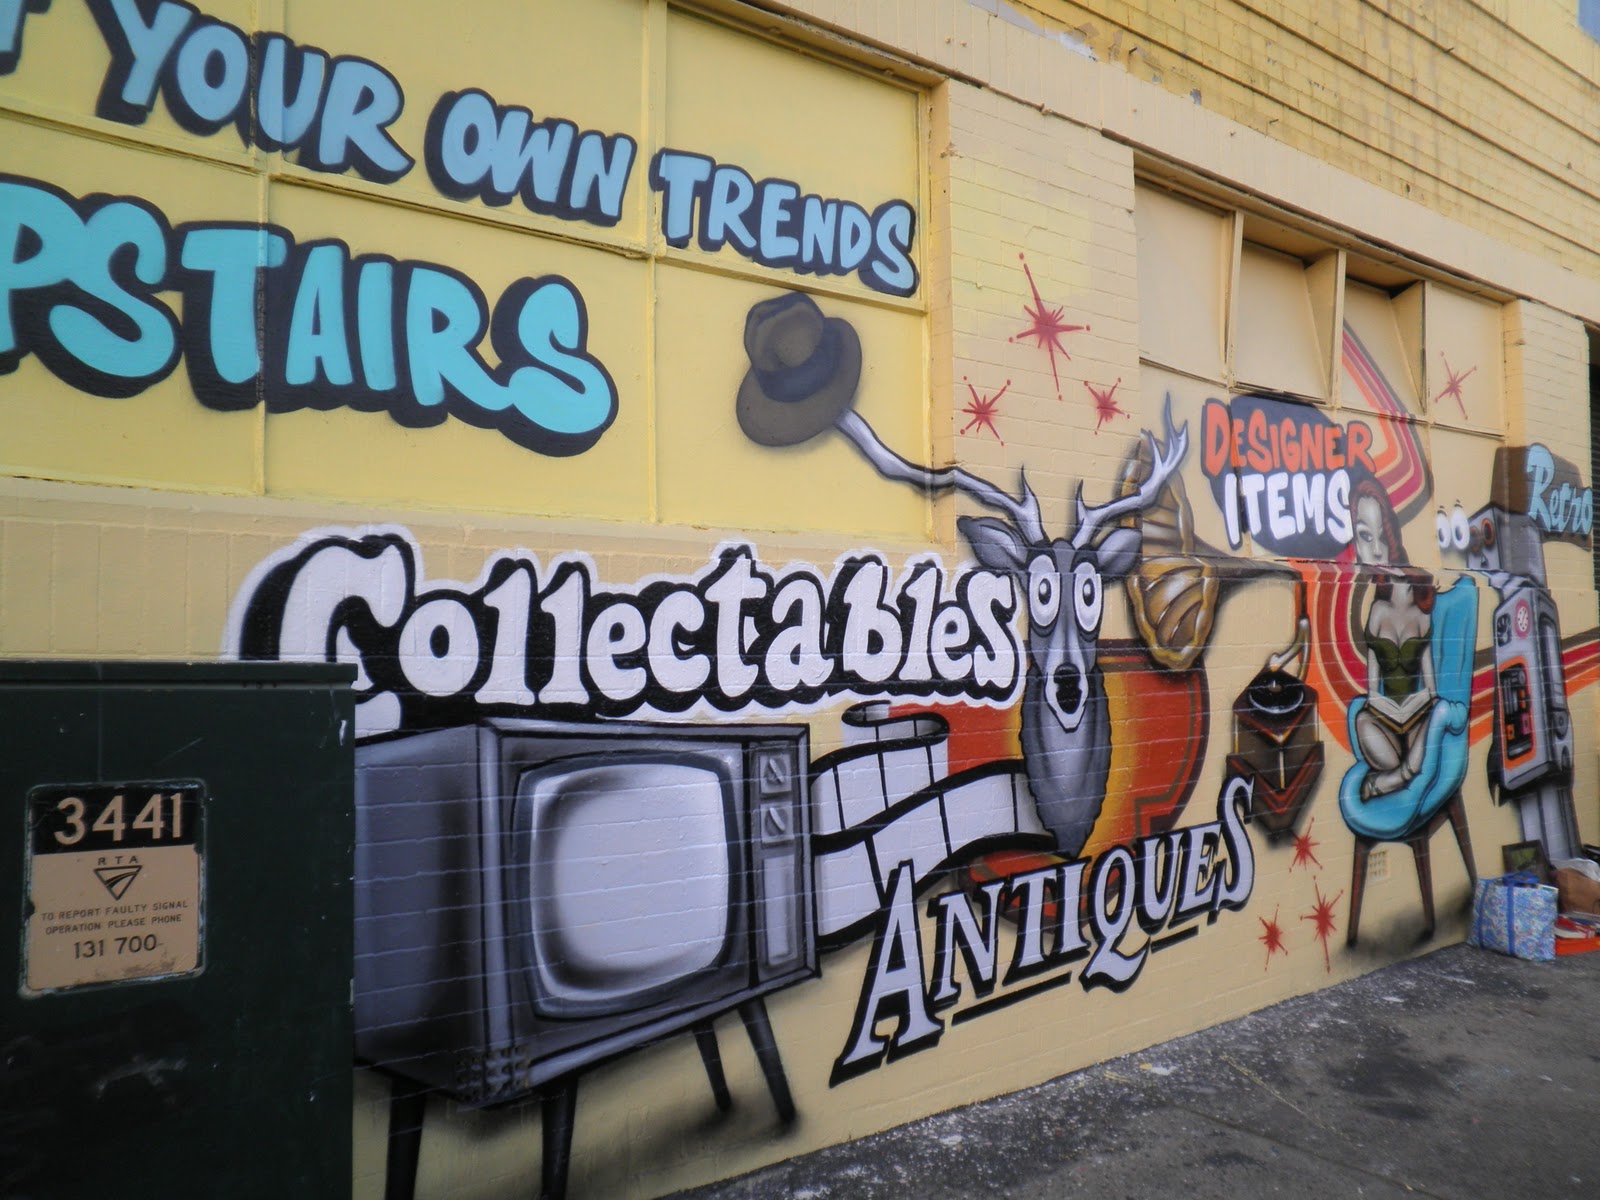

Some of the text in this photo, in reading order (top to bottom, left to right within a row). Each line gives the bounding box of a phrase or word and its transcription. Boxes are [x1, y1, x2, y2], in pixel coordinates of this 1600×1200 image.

[105, 0, 413, 177] YOUR
[434, 90, 637, 220] OWN
[655, 150, 918, 294] TRENDS
[1204, 402, 1377, 477] DESIGNER
[1224, 469, 1354, 545] ITEMS
[1526, 444, 1593, 535] Retro
[53, 791, 183, 847] 3441
[98, 855, 139, 866] RTA
[41, 900, 189, 922] TO REPORT FAULTY SIGNAL
[45, 913, 183, 936] OPERATION PLEASE PHONE
[834, 775, 1256, 1078] ANTIQUES
[73, 933, 158, 960] 131 700
